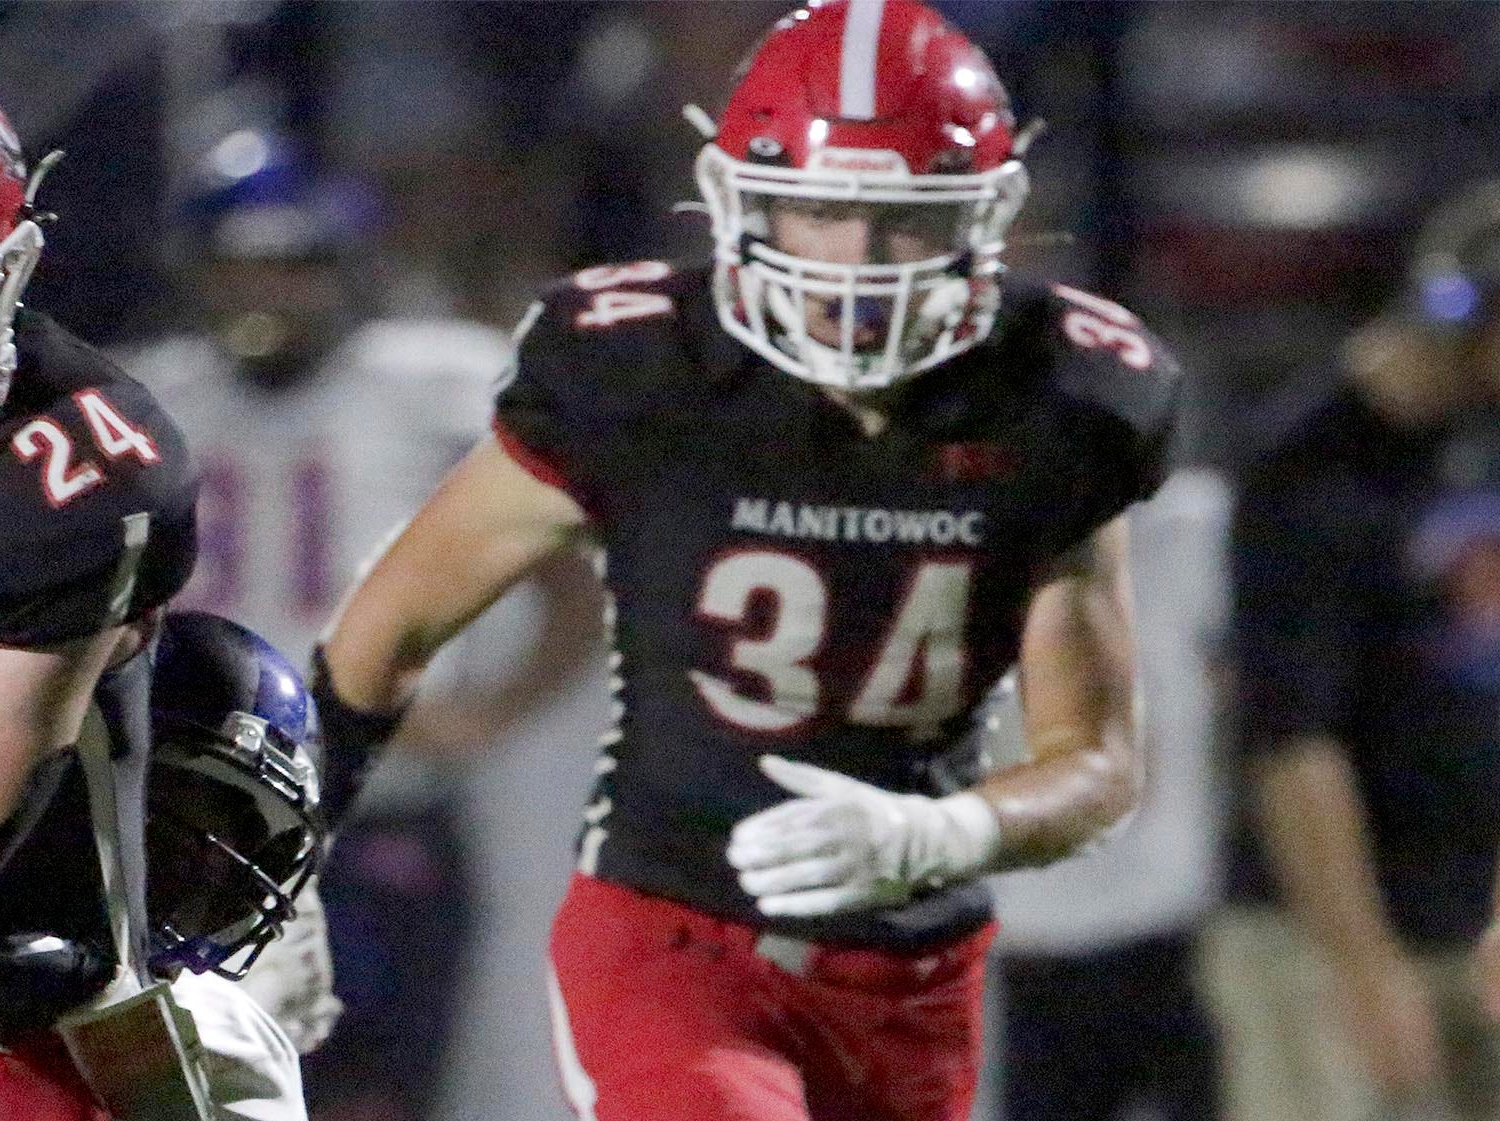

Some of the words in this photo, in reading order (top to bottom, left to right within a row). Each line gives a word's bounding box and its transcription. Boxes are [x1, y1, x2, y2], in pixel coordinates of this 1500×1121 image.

[13, 387, 160, 508] 24
[733, 497, 984, 545] MANITOWOC
[692, 549, 974, 737] 34
